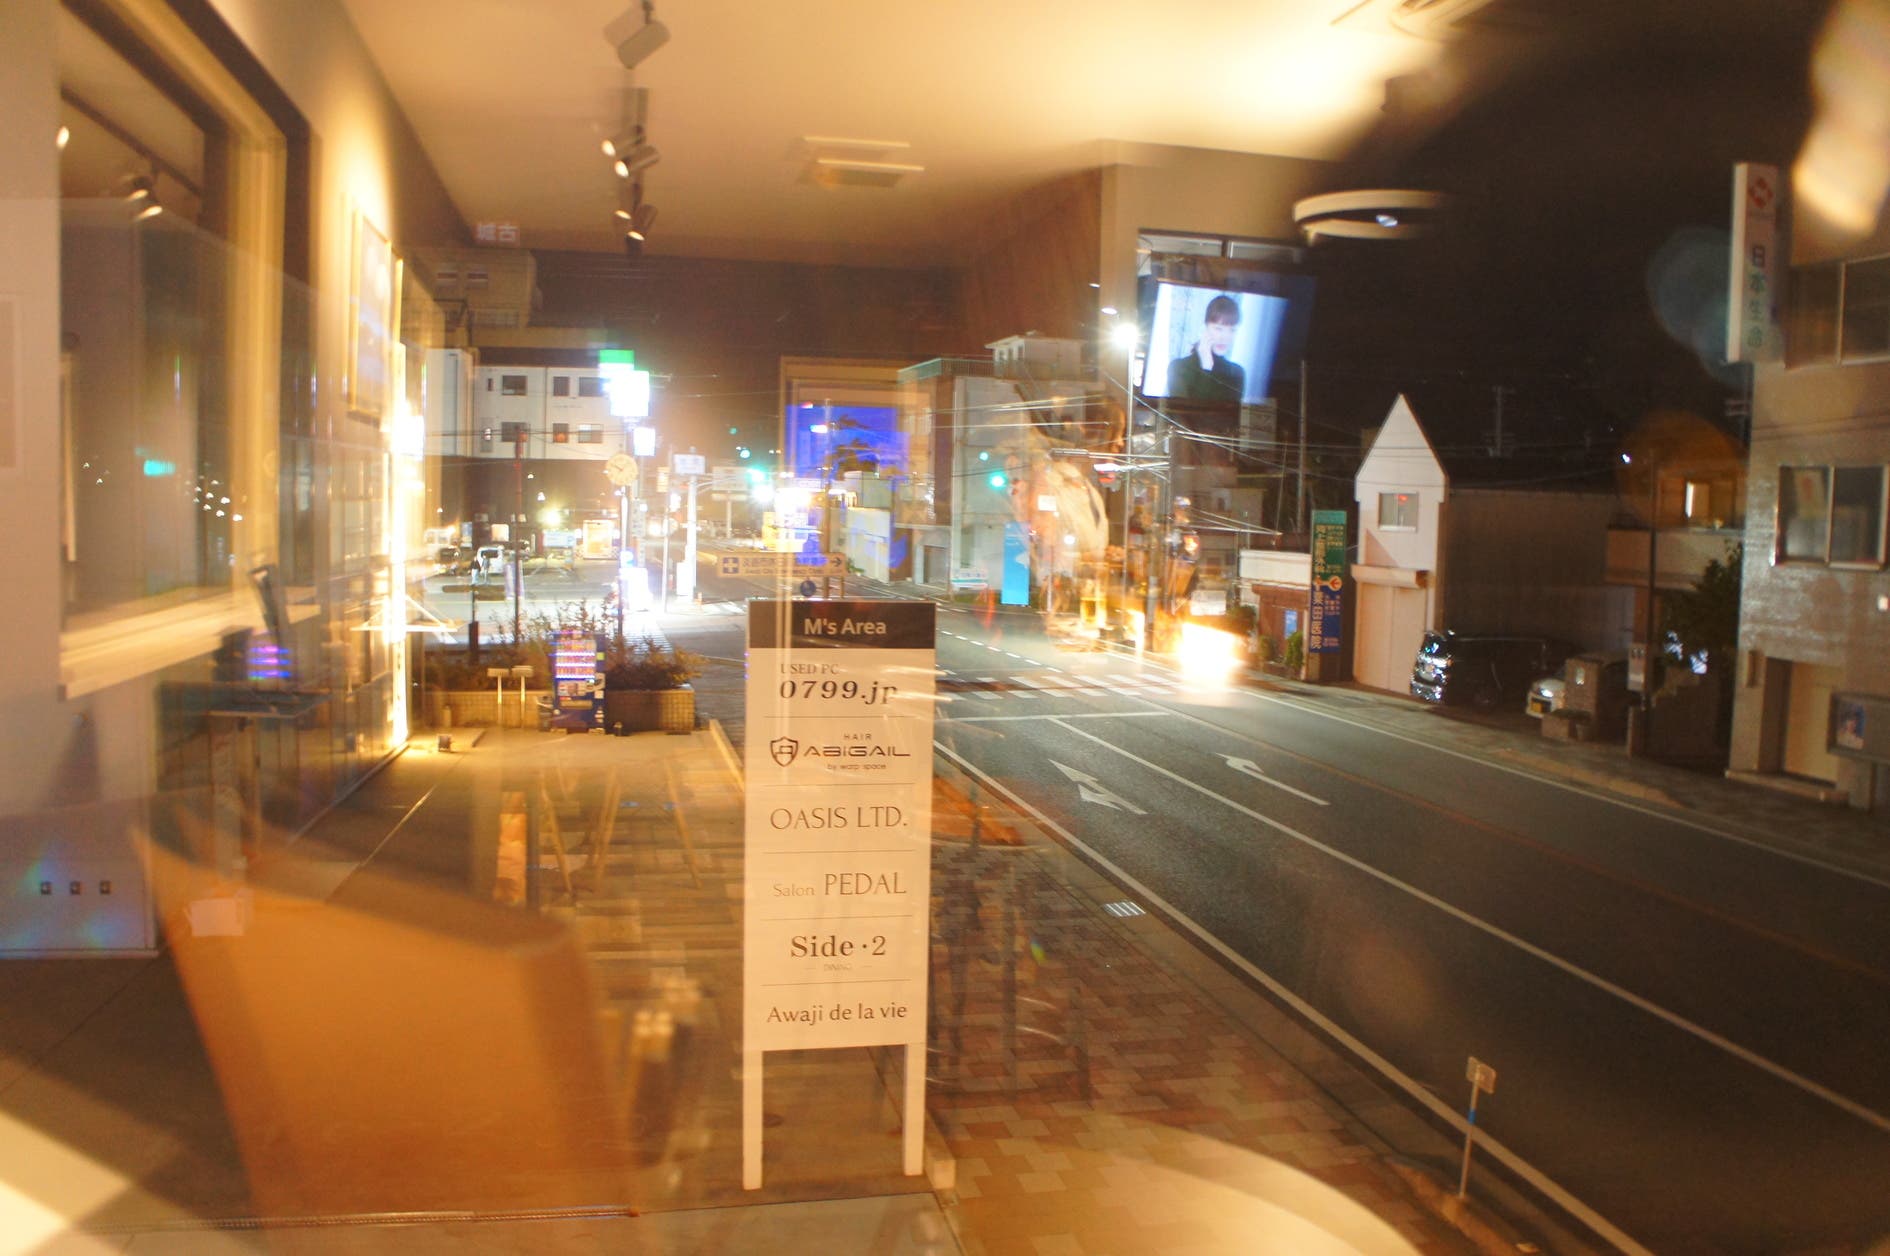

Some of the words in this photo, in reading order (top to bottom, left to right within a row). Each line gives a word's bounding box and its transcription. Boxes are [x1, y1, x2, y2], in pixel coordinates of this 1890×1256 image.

[1748, 245, 1767, 347] 日本生命
[804, 619, 837, 635] M's
[841, 619, 887, 635] Area
[821, 663, 839, 675] PC
[780, 680, 899, 705] 0799.jp
[863, 763, 887, 771] space
[770, 807, 848, 830] OASIS
[857, 806, 908, 828] LTD.
[773, 884, 815, 897] Salon
[824, 871, 907, 896] PEDAL
[767, 1004, 823, 1026] Awaji
[829, 1003, 852, 1021] de
[858, 1002, 875, 1020] la
[879, 1002, 908, 1019] vie
